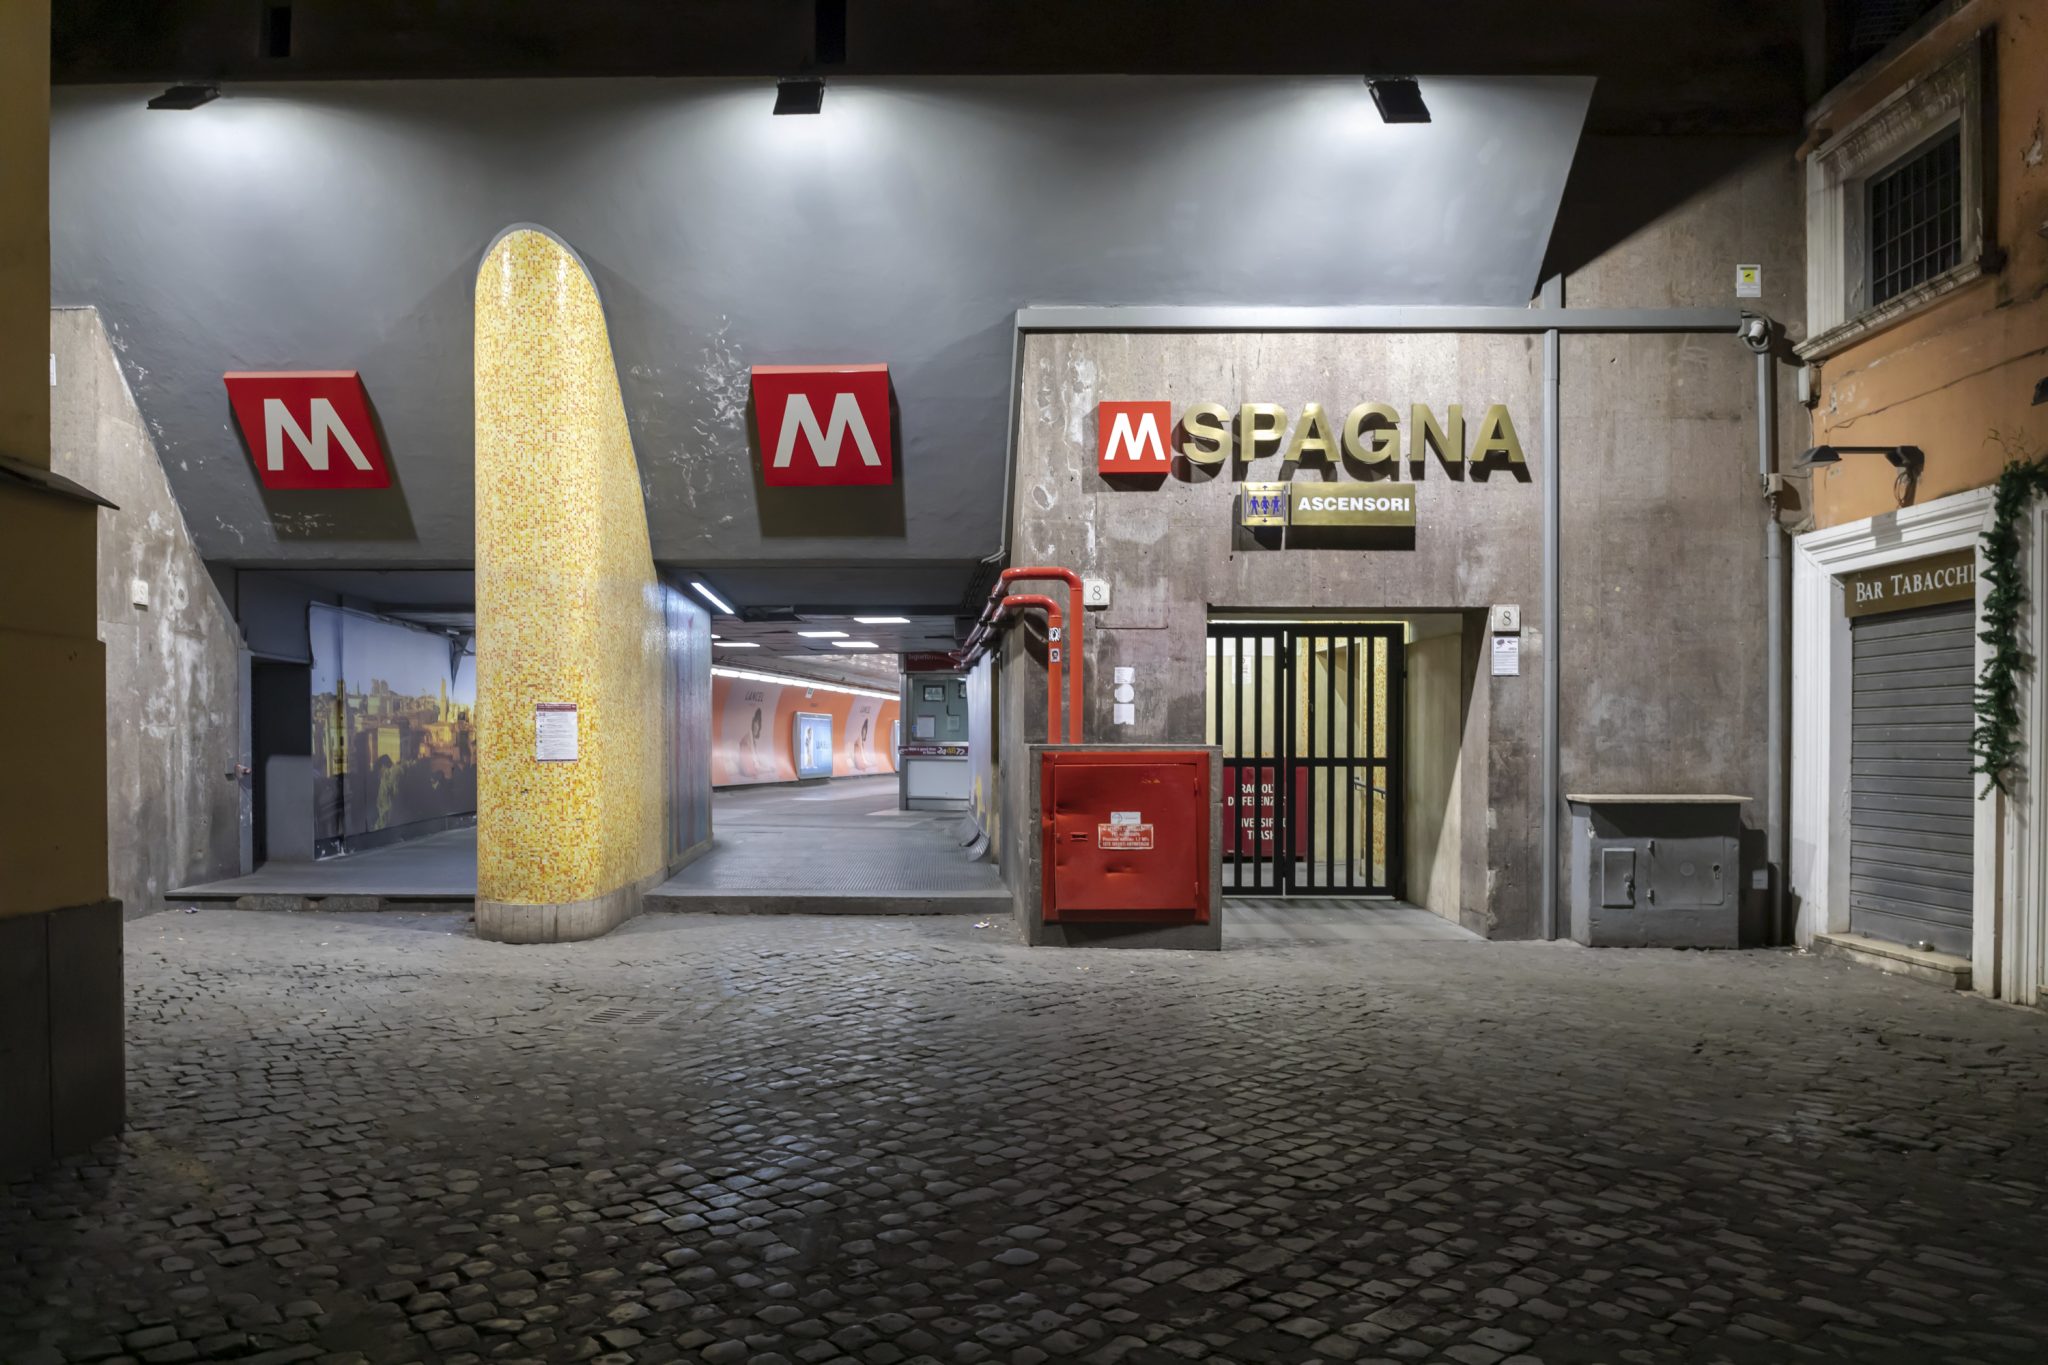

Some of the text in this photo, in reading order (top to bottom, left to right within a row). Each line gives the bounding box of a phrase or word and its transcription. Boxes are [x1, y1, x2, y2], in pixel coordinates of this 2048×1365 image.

[264, 398, 373, 471] M
[773, 392, 882, 467] M
[1104, 402, 1524, 465] M SPAGNA
[1298, 497, 1410, 512] ASCENSORI
[1092, 585, 1102, 601] 8
[1856, 563, 1976, 602] BAR TABACCHI
[1503, 610, 1512, 626] 8
